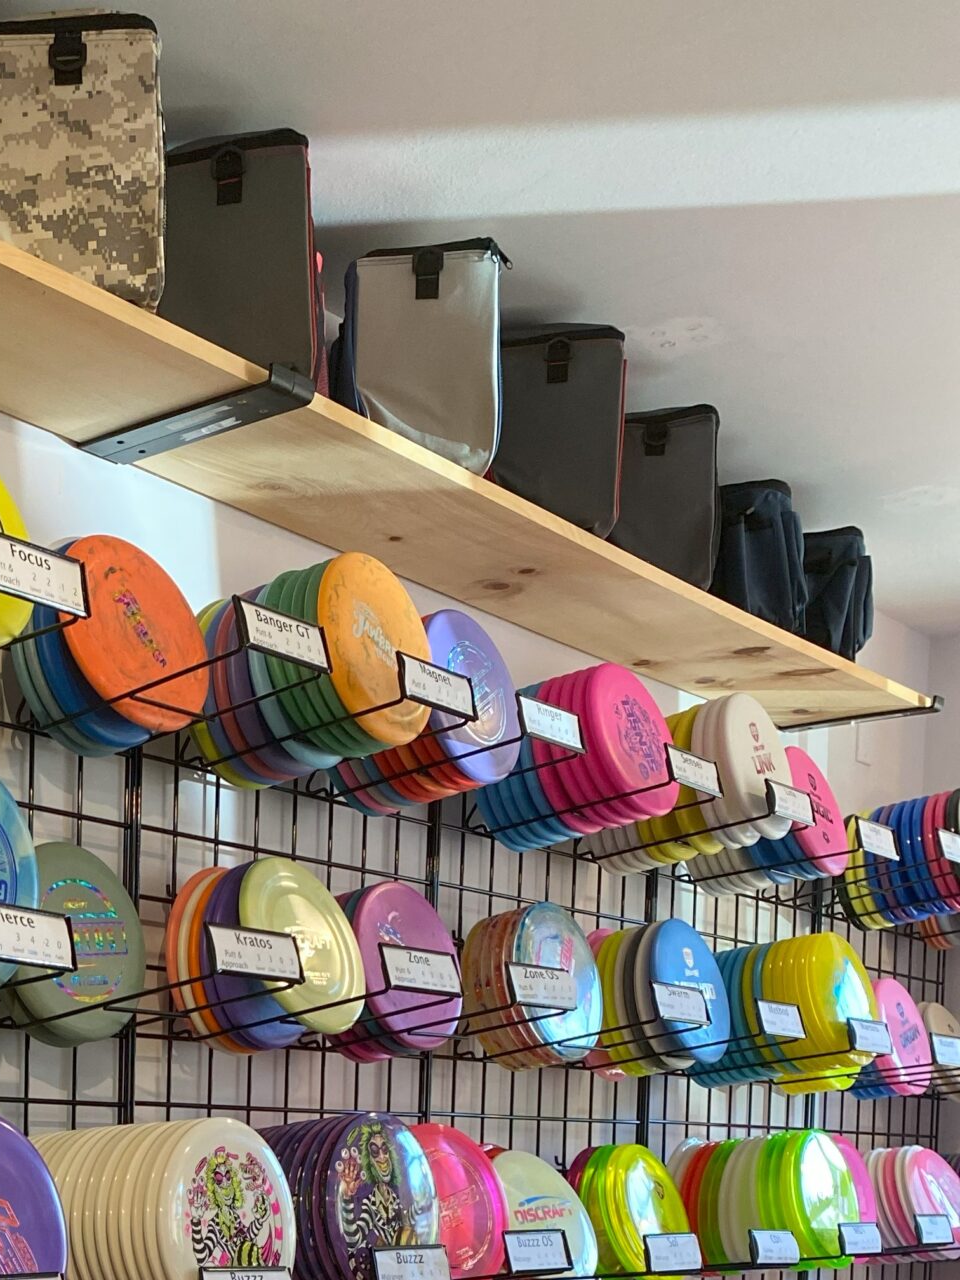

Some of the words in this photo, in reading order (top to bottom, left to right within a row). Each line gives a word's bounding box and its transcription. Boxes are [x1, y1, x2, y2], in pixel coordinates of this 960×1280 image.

[10, 543, 51, 571] Focus
[255, 609, 292, 633] Banger
[296, 625, 309, 639] GT
[419, 662, 452, 687] Magnet
[234, 933, 273, 950] Kratos
[405, 952, 431, 966] Zone
[523, 967, 545, 979] Zone
[547, 970, 560, 981] OS
[517, 1237, 540, 1248] Buzzz
[542, 1236, 552, 1246] OS
[396, 1252, 424, 1265] Buzzz
